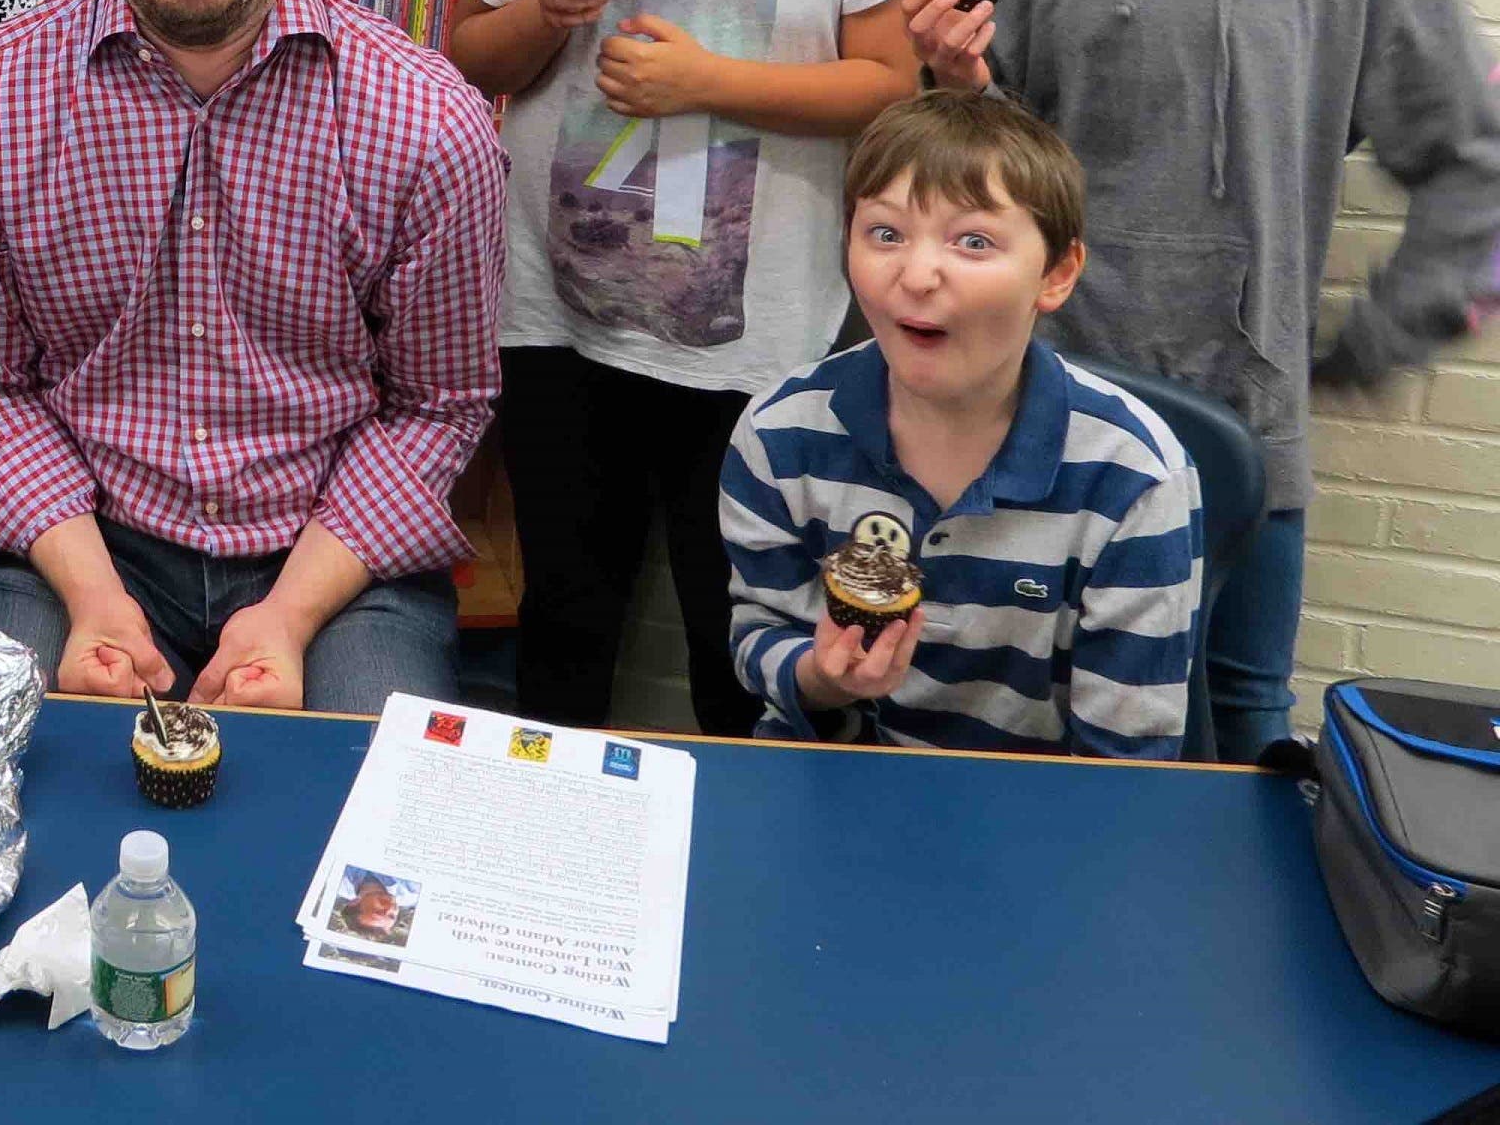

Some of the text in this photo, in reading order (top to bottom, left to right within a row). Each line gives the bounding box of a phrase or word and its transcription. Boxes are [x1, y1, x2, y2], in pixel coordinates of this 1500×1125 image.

[451, 928, 633, 973] Win Lunchtime with
[515, 928, 569, 947] Adam
[572, 937, 635, 957] Author
[484, 950, 632, 988] Writing Contest:
[476, 977, 626, 1021] Writing Contest:
